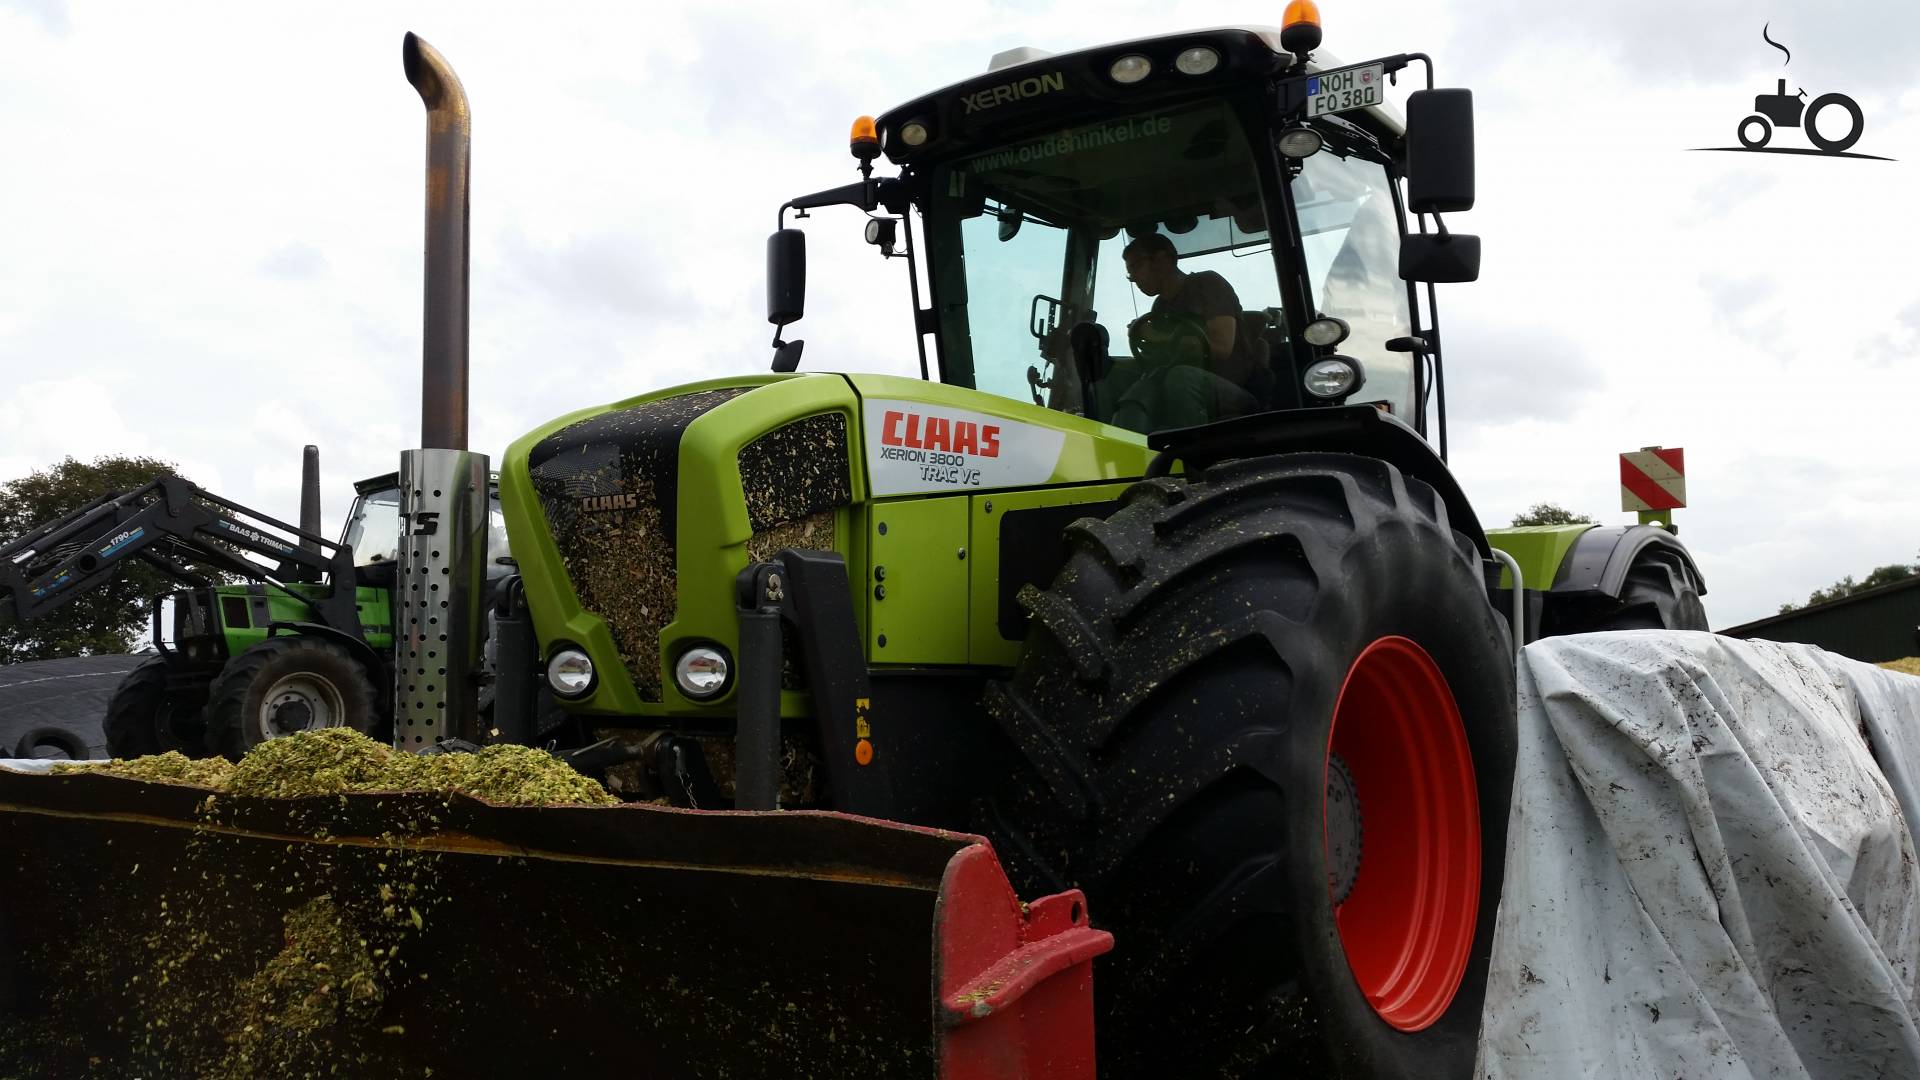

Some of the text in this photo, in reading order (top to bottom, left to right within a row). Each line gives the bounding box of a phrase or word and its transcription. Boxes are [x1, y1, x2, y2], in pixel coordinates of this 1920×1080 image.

[960, 71, 1065, 114] XERION
[1320, 72, 1354, 94] NOH
[1315, 86, 1375, 114] FO 380
[971, 115, 1172, 174] www.oudehinkel.de
[881, 410, 1001, 458] CLAAS
[880, 447, 965, 467] XERION 3800
[919, 463, 981, 485] TRAC VC
[582, 493, 637, 511] CLAAS
[110, 531, 129, 546] 1790
[229, 523, 284, 551] BAAS TRIMA
